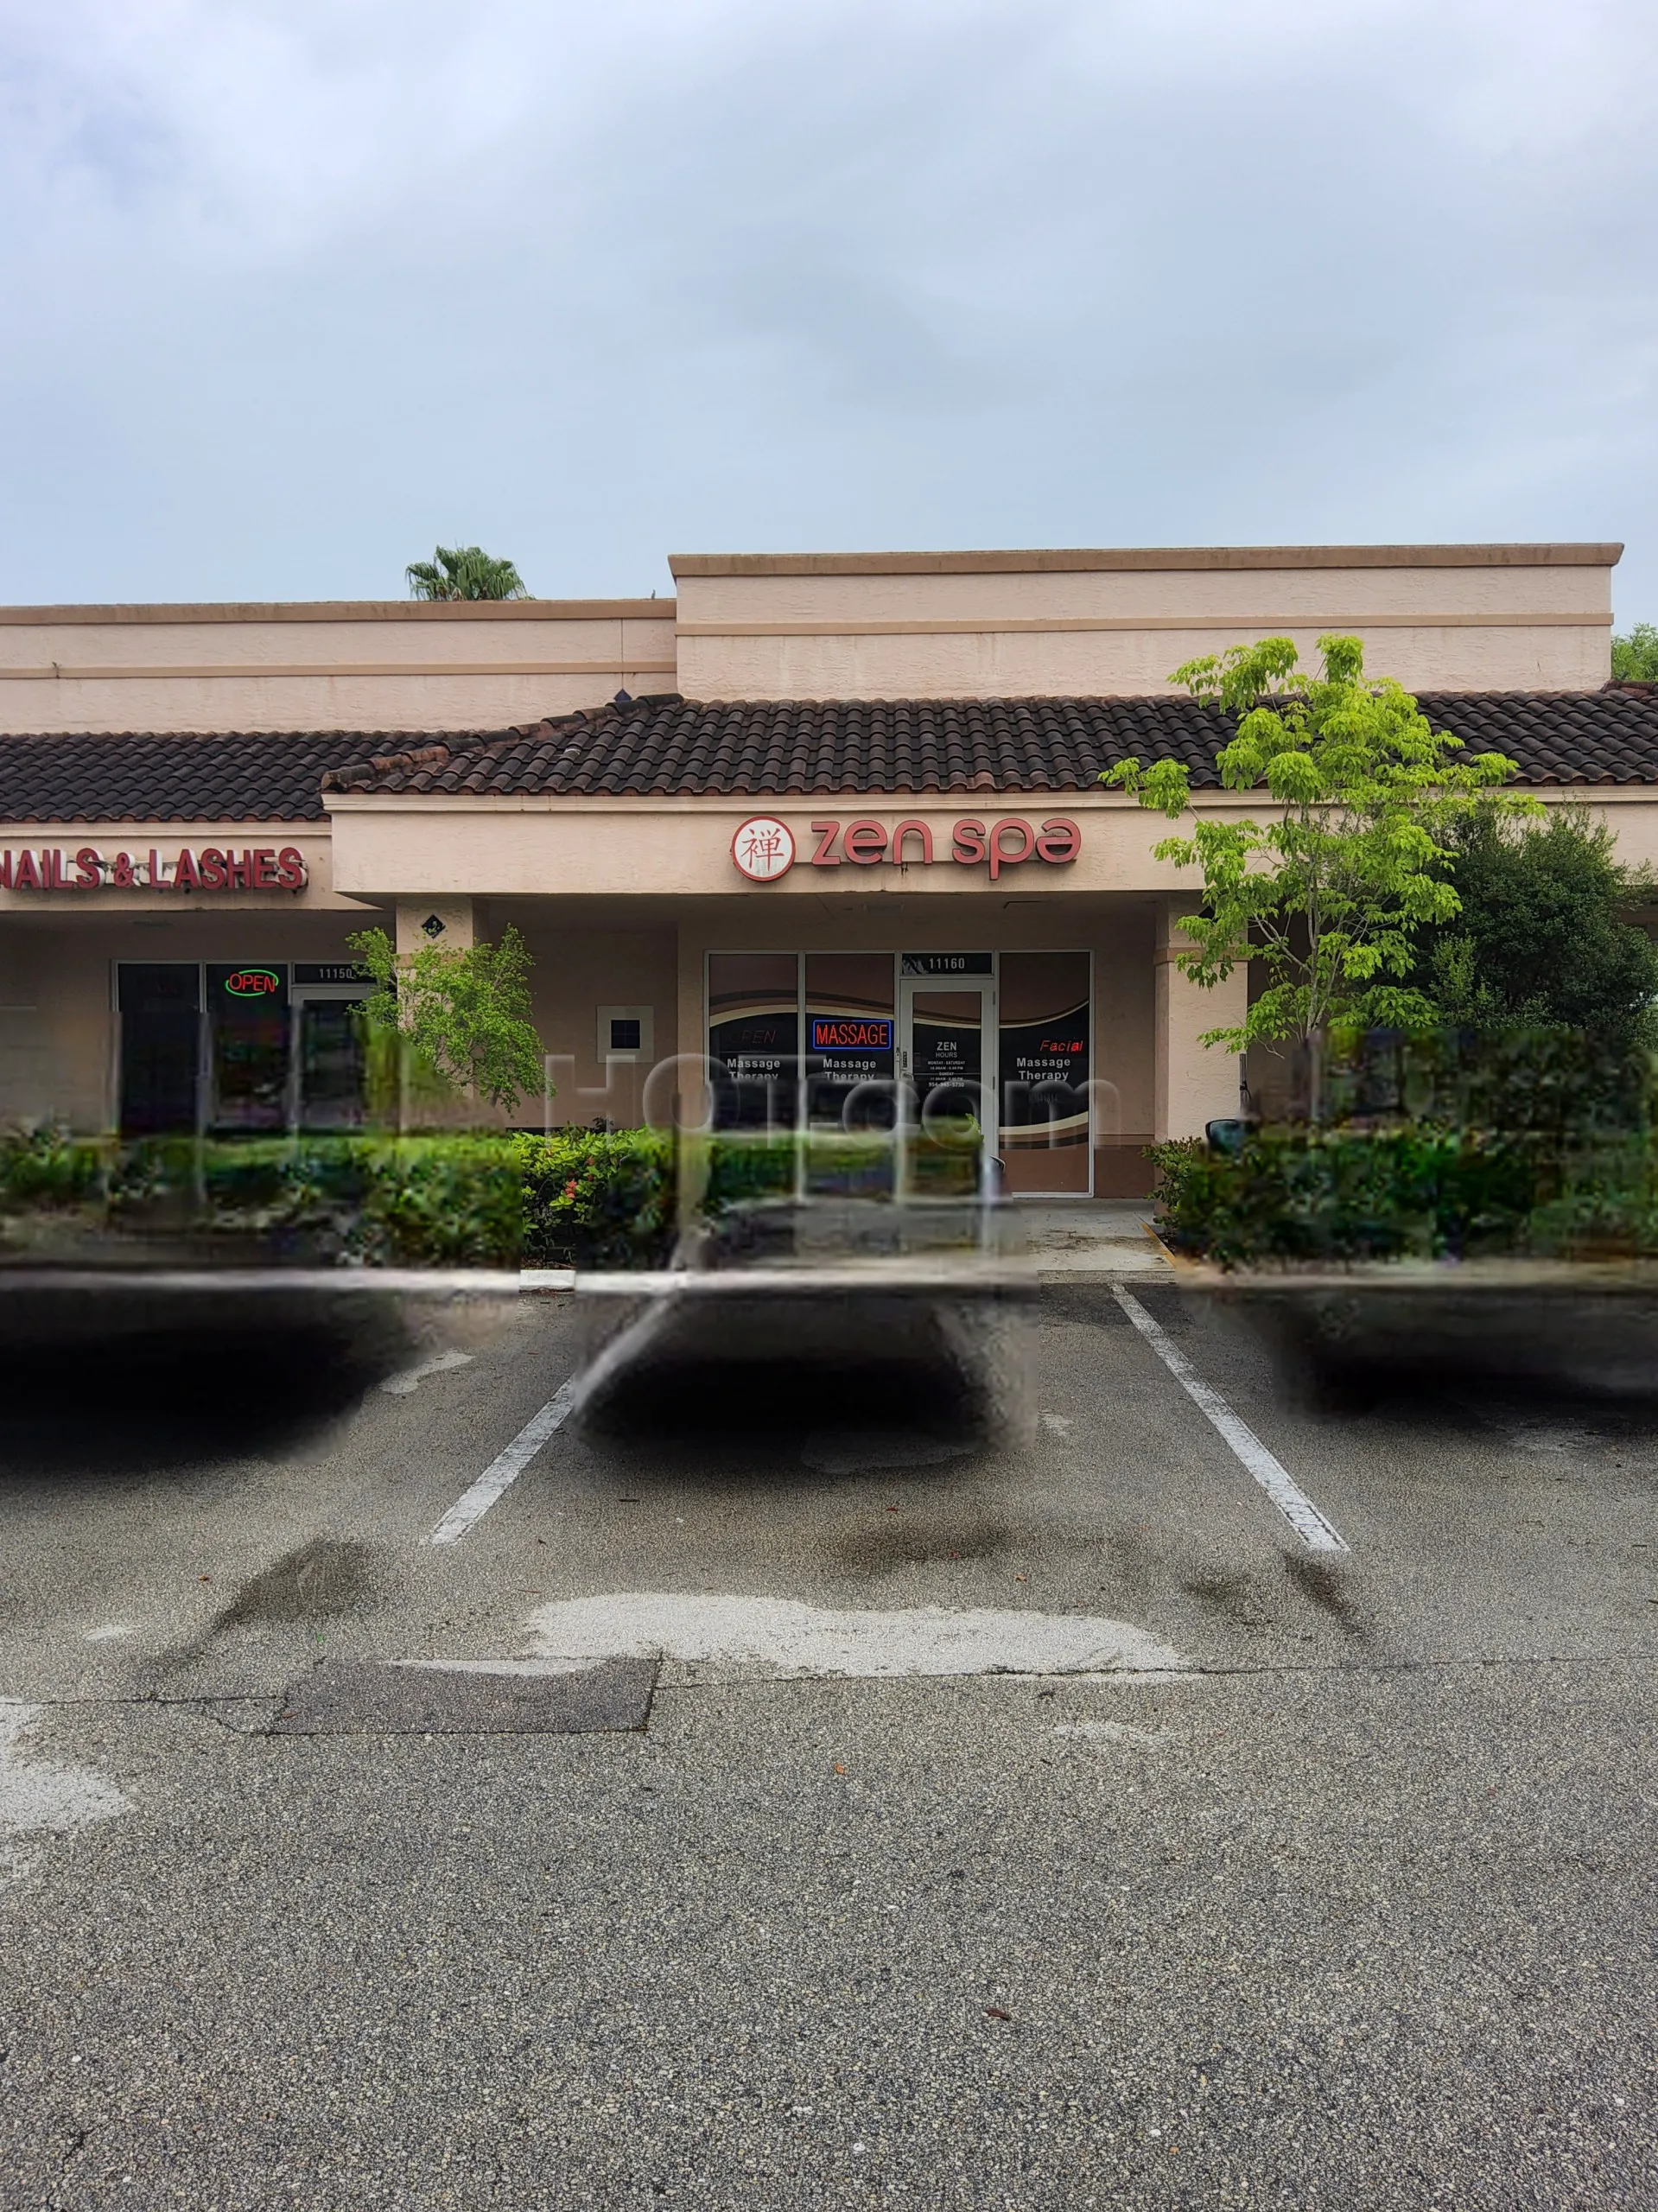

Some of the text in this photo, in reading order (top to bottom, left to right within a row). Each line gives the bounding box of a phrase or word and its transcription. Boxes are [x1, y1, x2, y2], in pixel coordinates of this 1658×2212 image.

[810, 819, 934, 866] zen
[113, 852, 136, 887] &
[149, 847, 306, 890] LASHES
[929, 957, 966, 969] 11160
[319, 967, 353, 980] 11150
[229, 972, 276, 993] OPEN
[816, 1023, 889, 1046] MASSAGE
[937, 1041, 956, 1051] ZEN
[1039, 1039, 1084, 1052] Facial
[727, 1058, 781, 1071] Massage
[823, 1058, 877, 1071] Massage
[1016, 1056, 1071, 1070] Massage
[1018, 1069, 1070, 1082] Therapy
